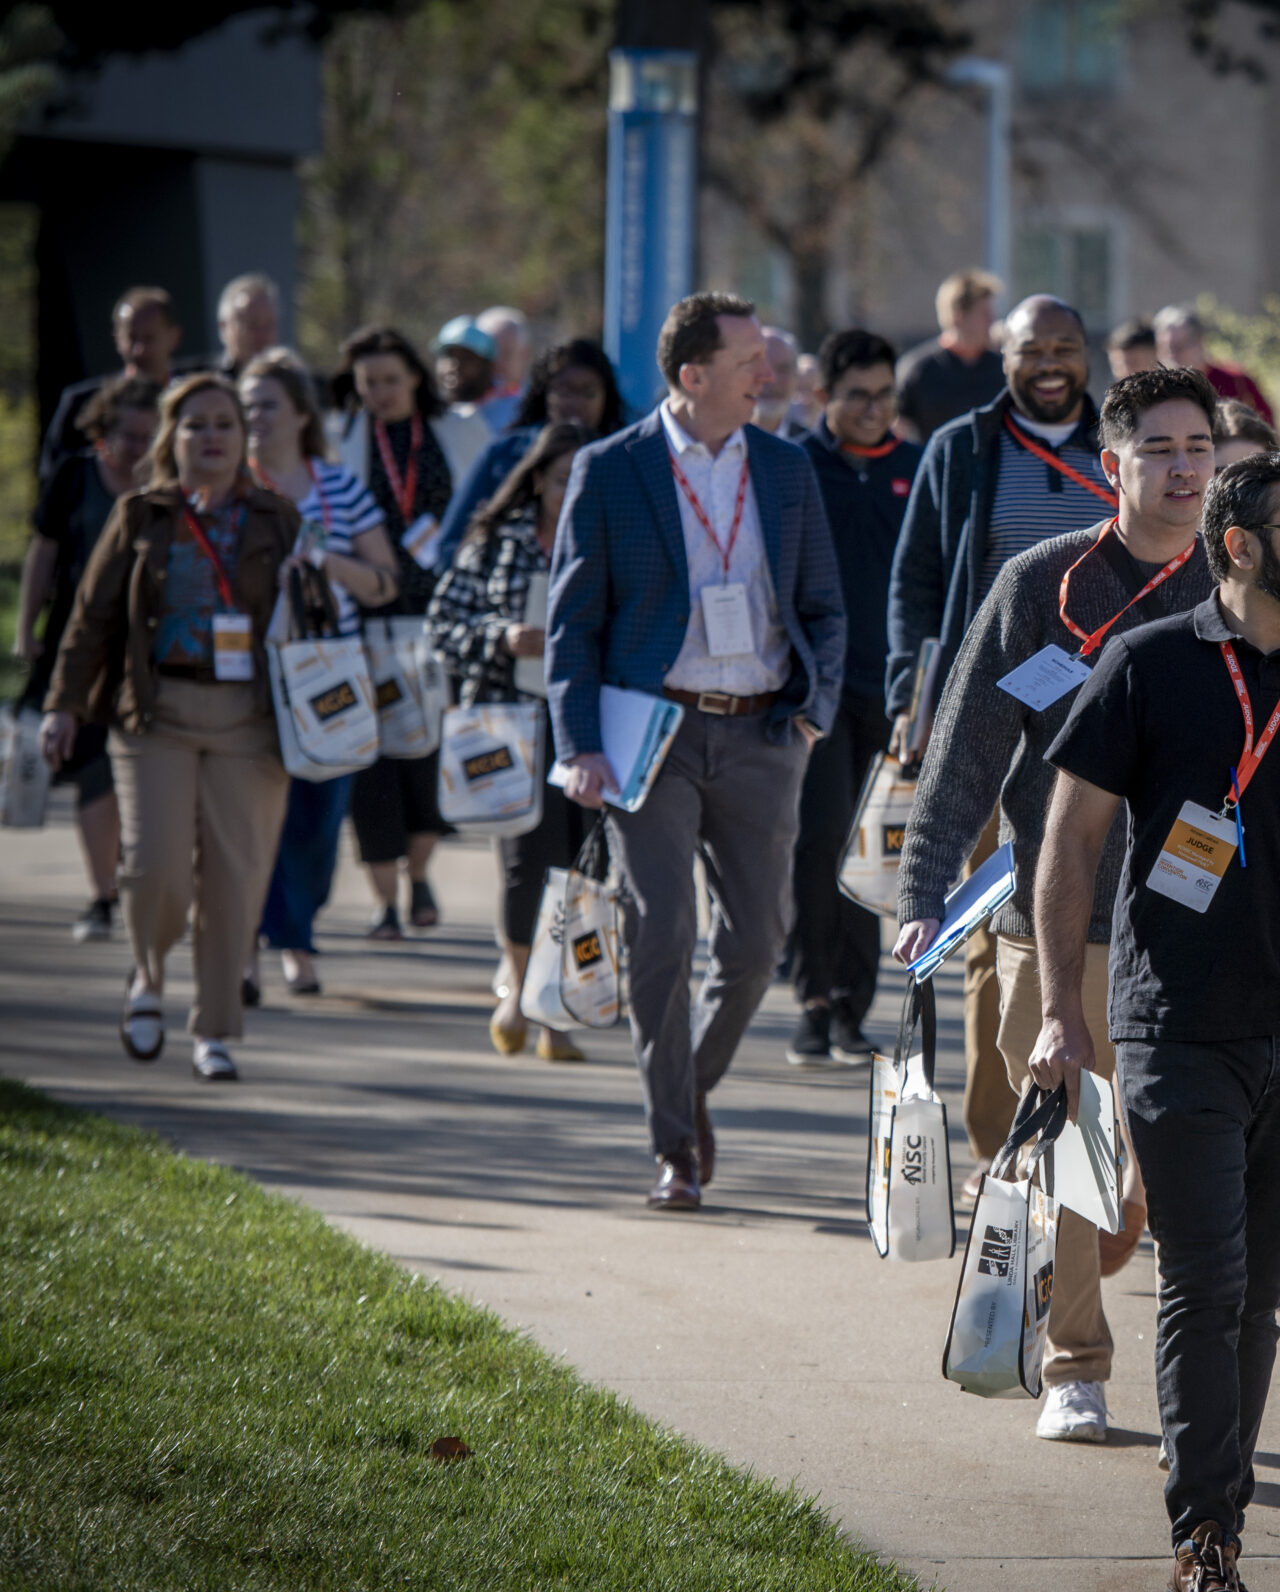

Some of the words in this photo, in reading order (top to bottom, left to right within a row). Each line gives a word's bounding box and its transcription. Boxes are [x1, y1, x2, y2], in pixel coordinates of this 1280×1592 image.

[1226, 653, 1238, 673] JUDGE
[1268, 712, 1280, 734] JUDGE
[1186, 837, 1215, 854] JUDGE
[902, 1135, 921, 1186] NSC
